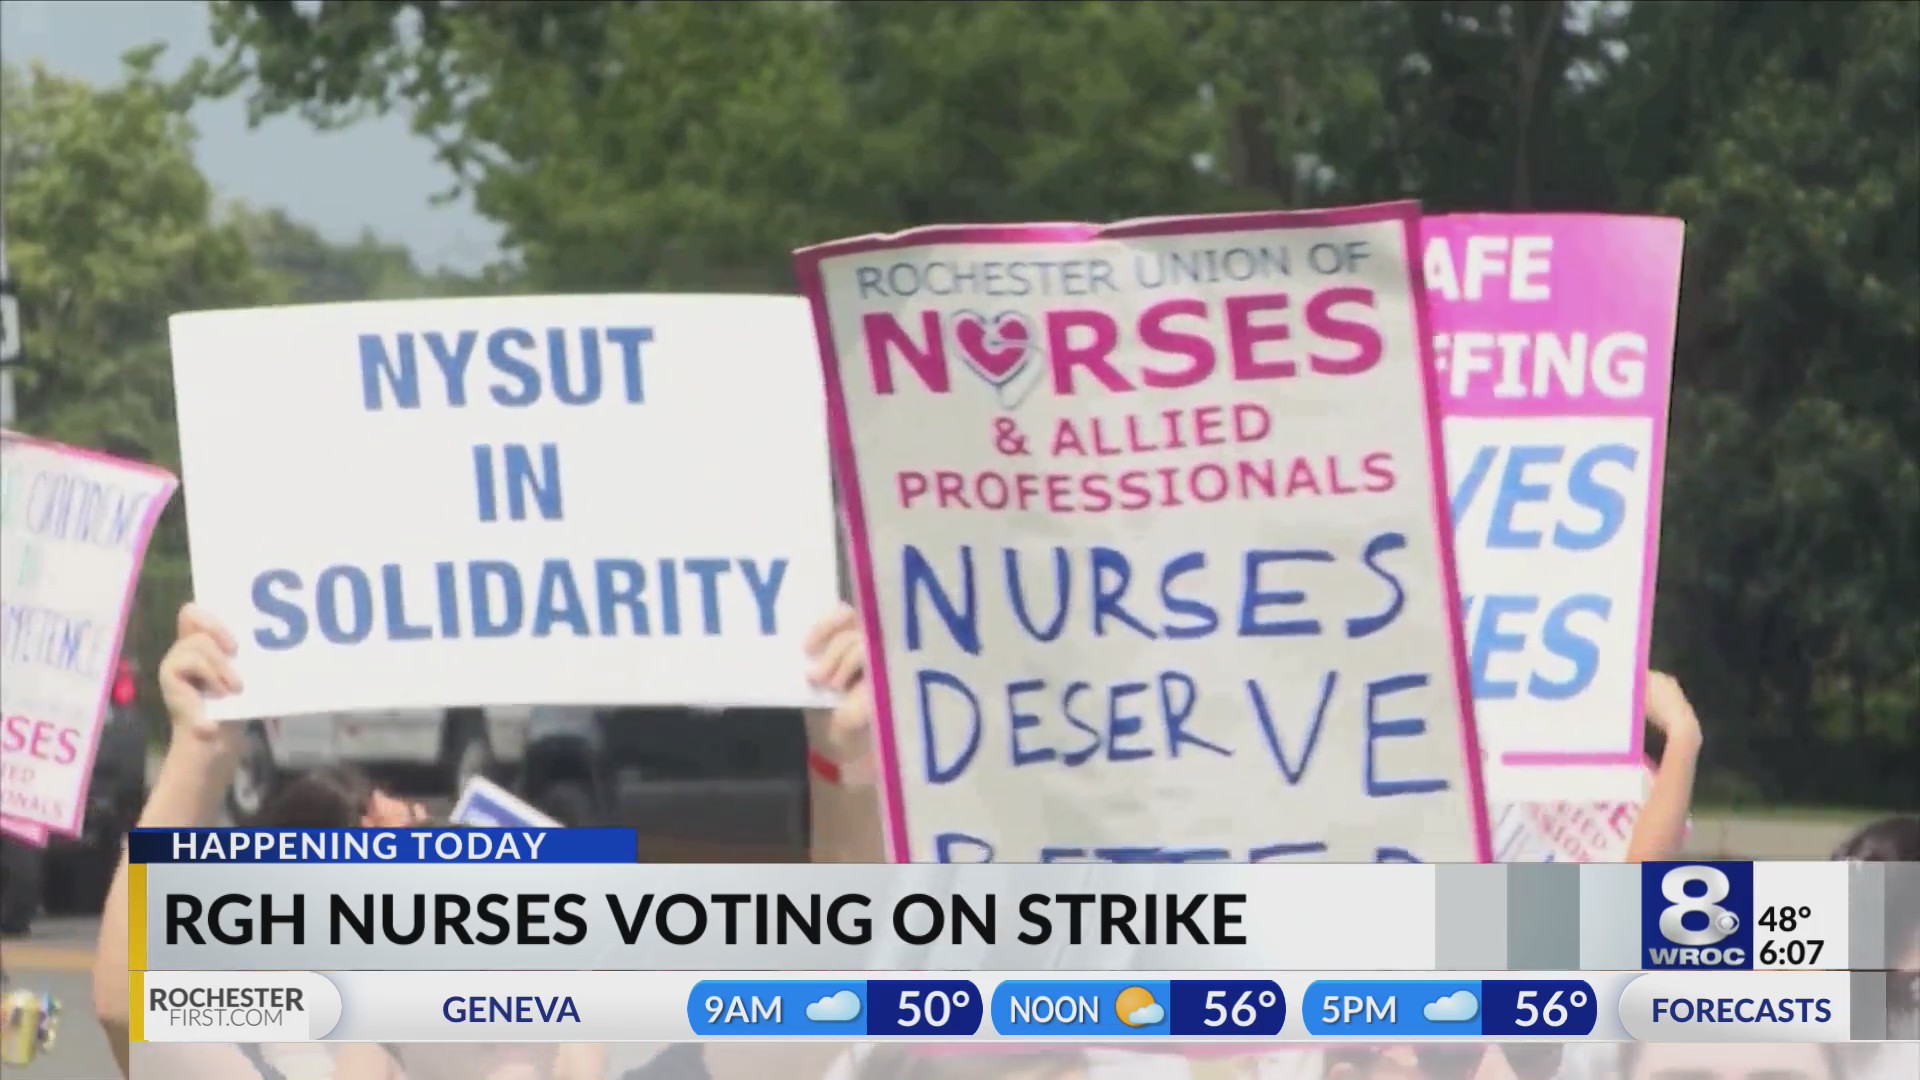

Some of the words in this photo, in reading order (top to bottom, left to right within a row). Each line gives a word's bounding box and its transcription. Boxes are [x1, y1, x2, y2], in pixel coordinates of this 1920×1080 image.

[856, 260, 1118, 300] ROCHESTER
[1133, 247, 1291, 289] UNION
[1308, 240, 1371, 275] OF
[358, 326, 655, 411] NYSUT
[993, 417, 1027, 455] &
[1052, 402, 1272, 457] ALLIED
[472, 442, 564, 522] IN
[898, 452, 1396, 513] PROFESSIONALS
[251, 557, 789, 650] SOLIDARITY
[903, 532, 1406, 655] NURSES
[1462, 593, 1613, 701] ES
[917, 669, 1450, 797] DESERVE
